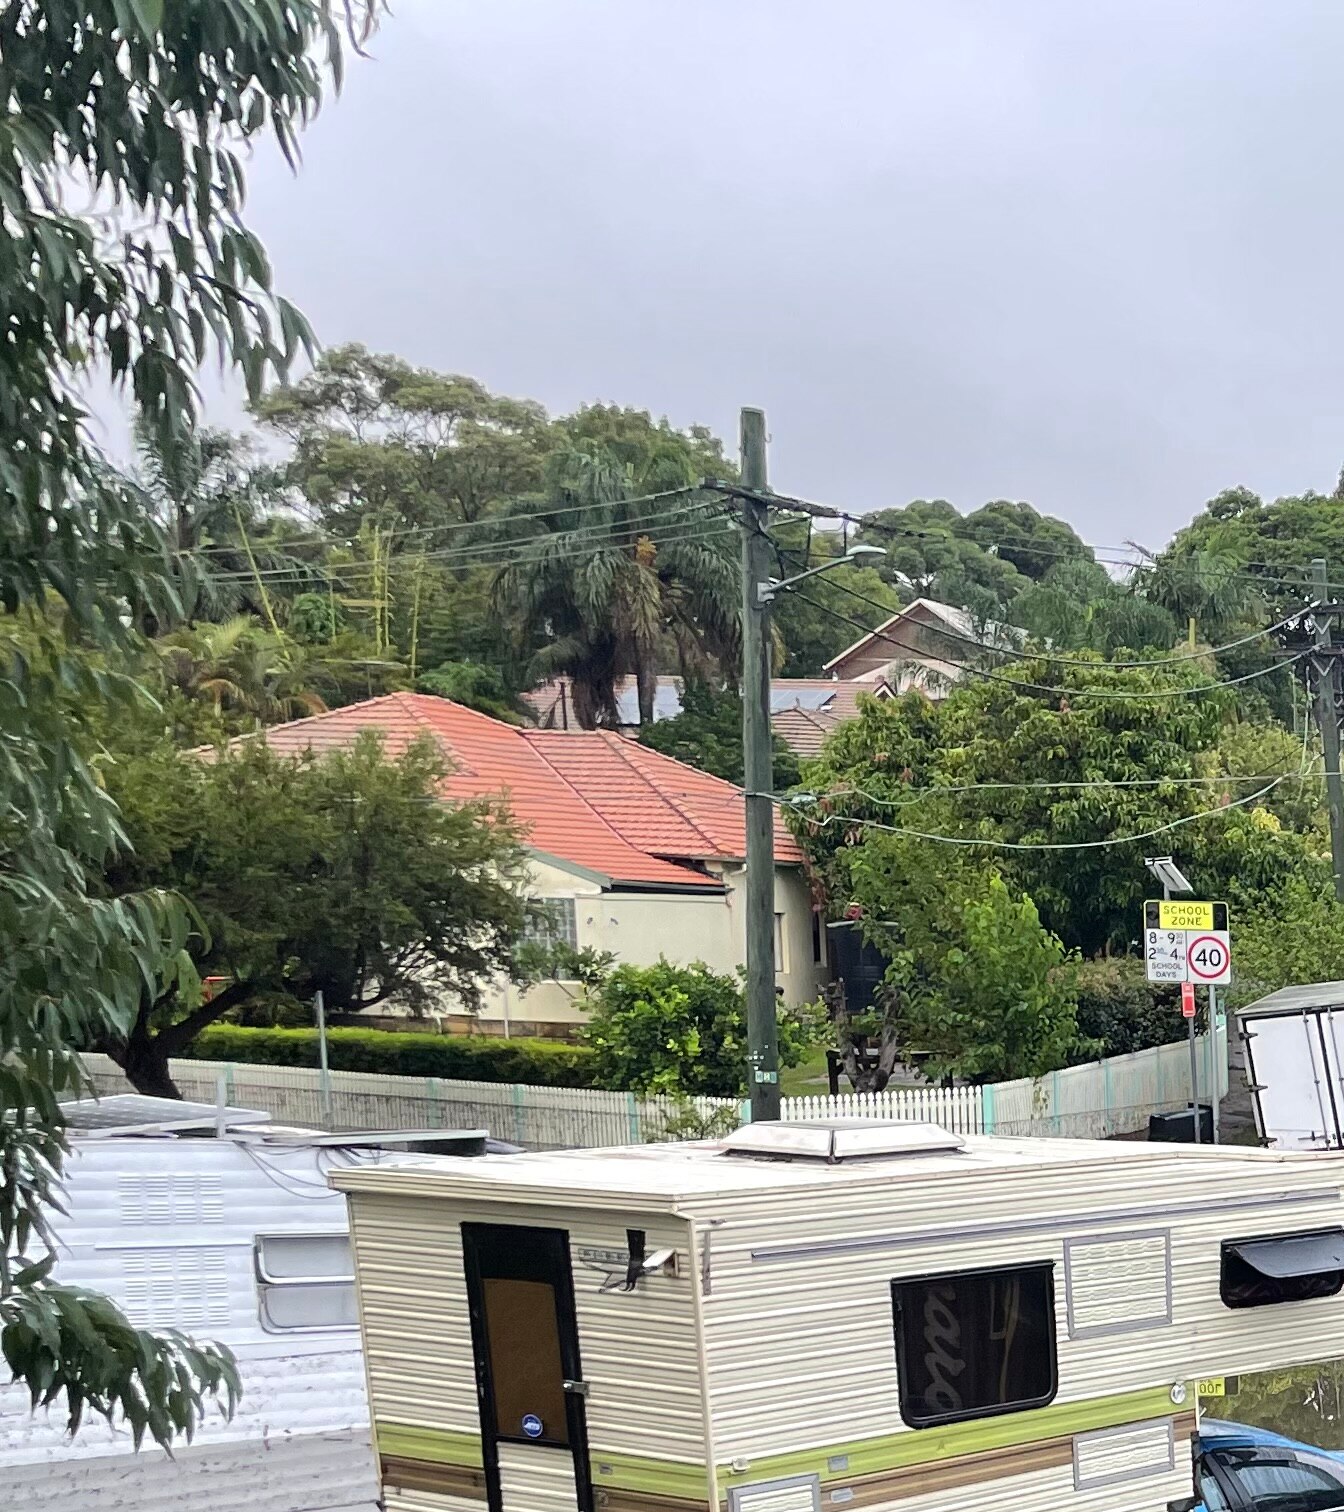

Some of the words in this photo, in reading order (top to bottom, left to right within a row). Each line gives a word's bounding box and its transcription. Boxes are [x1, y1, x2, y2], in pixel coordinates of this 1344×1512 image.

[1163, 905, 1210, 916] SCHOOL
[1171, 917, 1202, 926] ZONE
[1194, 948, 1222, 967] 40
[1152, 962, 1183, 970] SCHOOL
